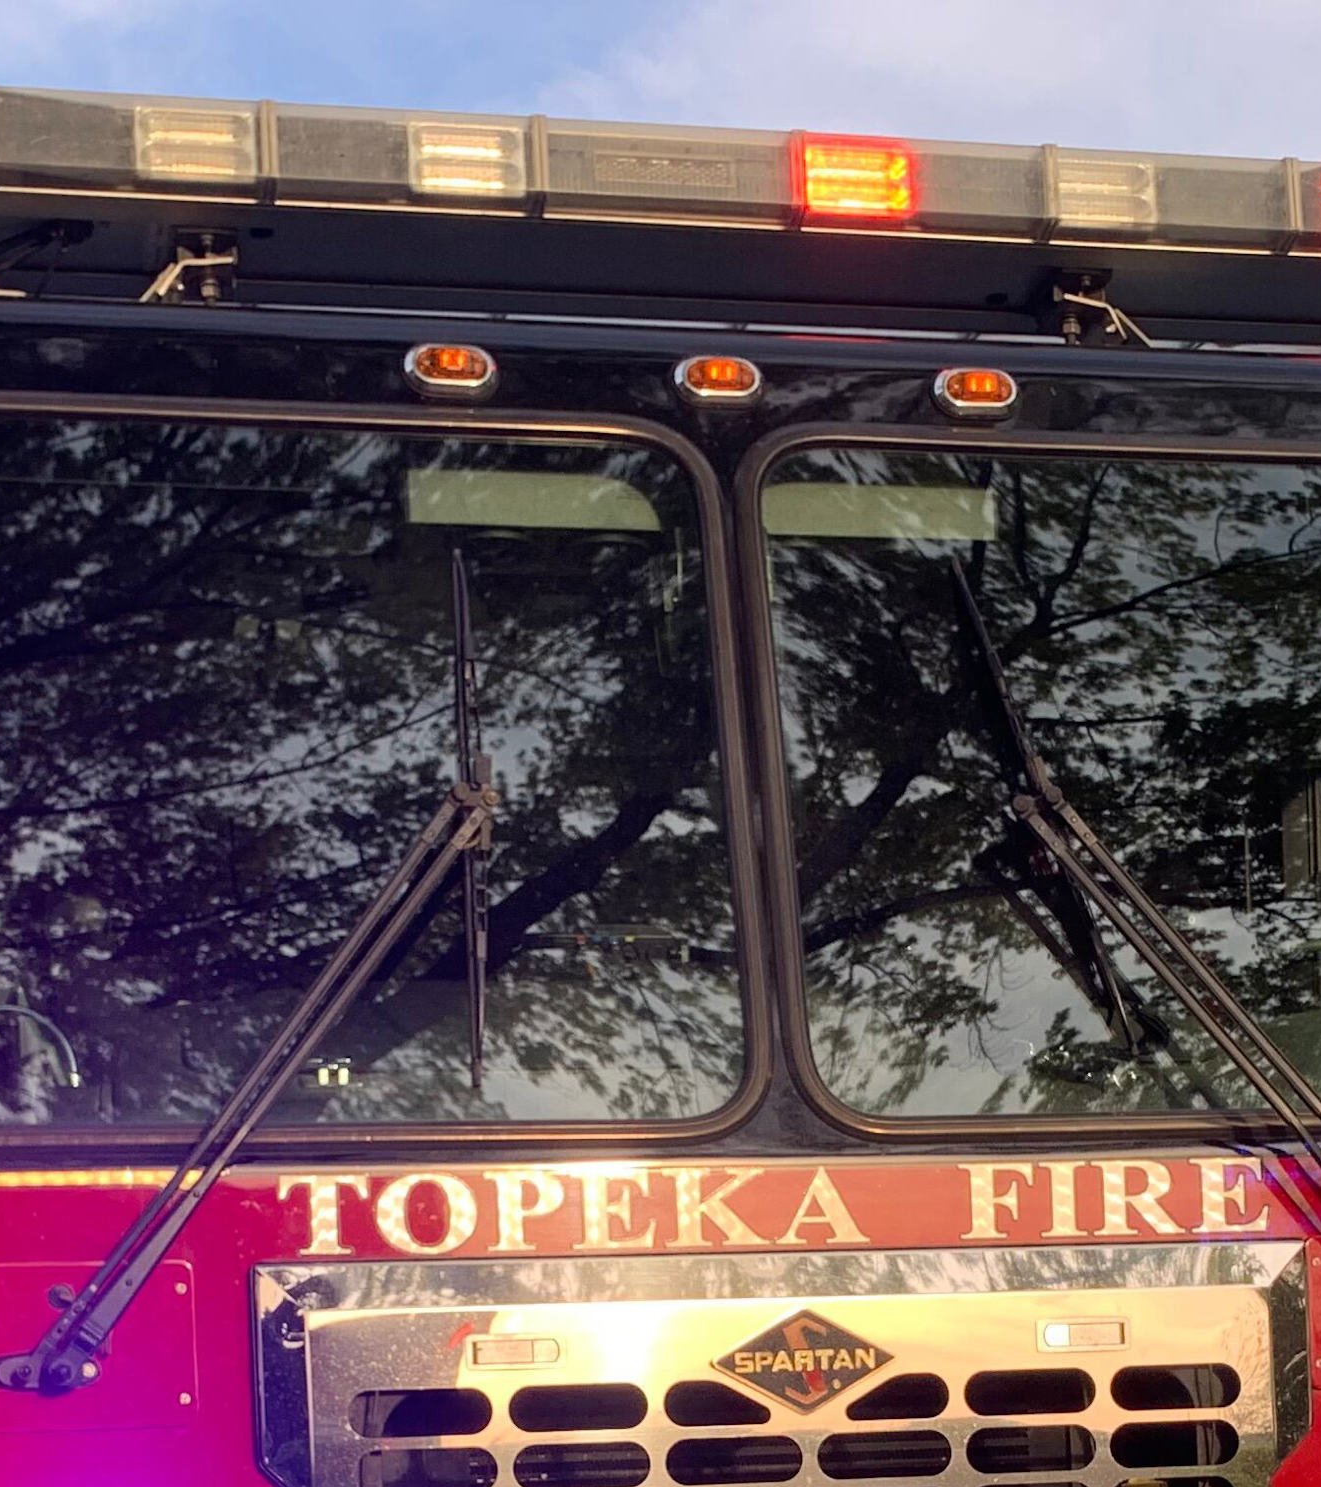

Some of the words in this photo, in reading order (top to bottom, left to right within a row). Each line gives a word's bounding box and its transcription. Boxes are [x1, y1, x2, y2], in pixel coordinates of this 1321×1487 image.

[278, 1166, 870, 1256] TOPEKA
[957, 1156, 1270, 1240] FIRE
[733, 1347, 876, 1374] SPARTAN
